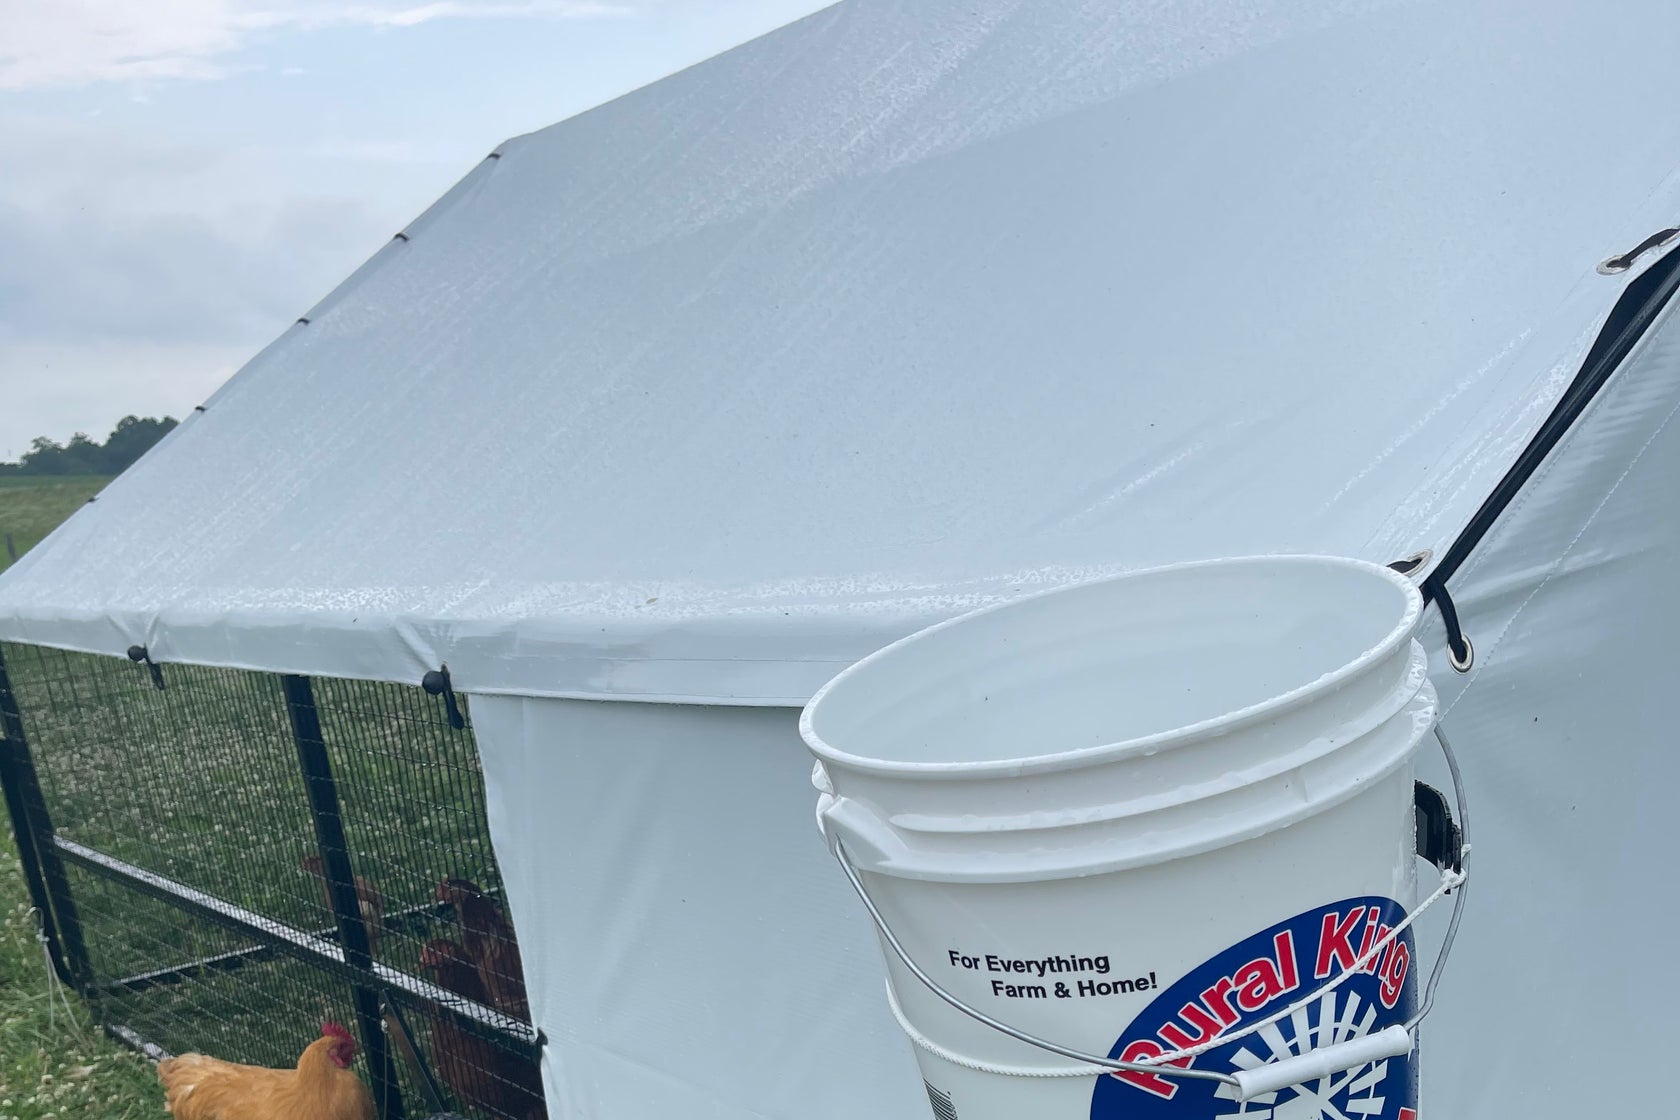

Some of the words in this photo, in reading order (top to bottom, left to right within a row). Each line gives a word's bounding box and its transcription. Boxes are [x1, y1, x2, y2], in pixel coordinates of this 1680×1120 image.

[948, 950, 980, 970] For
[985, 955, 1110, 977] Everything
[991, 980, 1047, 999] Farm
[1054, 982, 1072, 998] &
[1077, 972, 1157, 997] Home!
[1110, 929, 1300, 1100] Rural
[1314, 905, 1409, 1010] King
